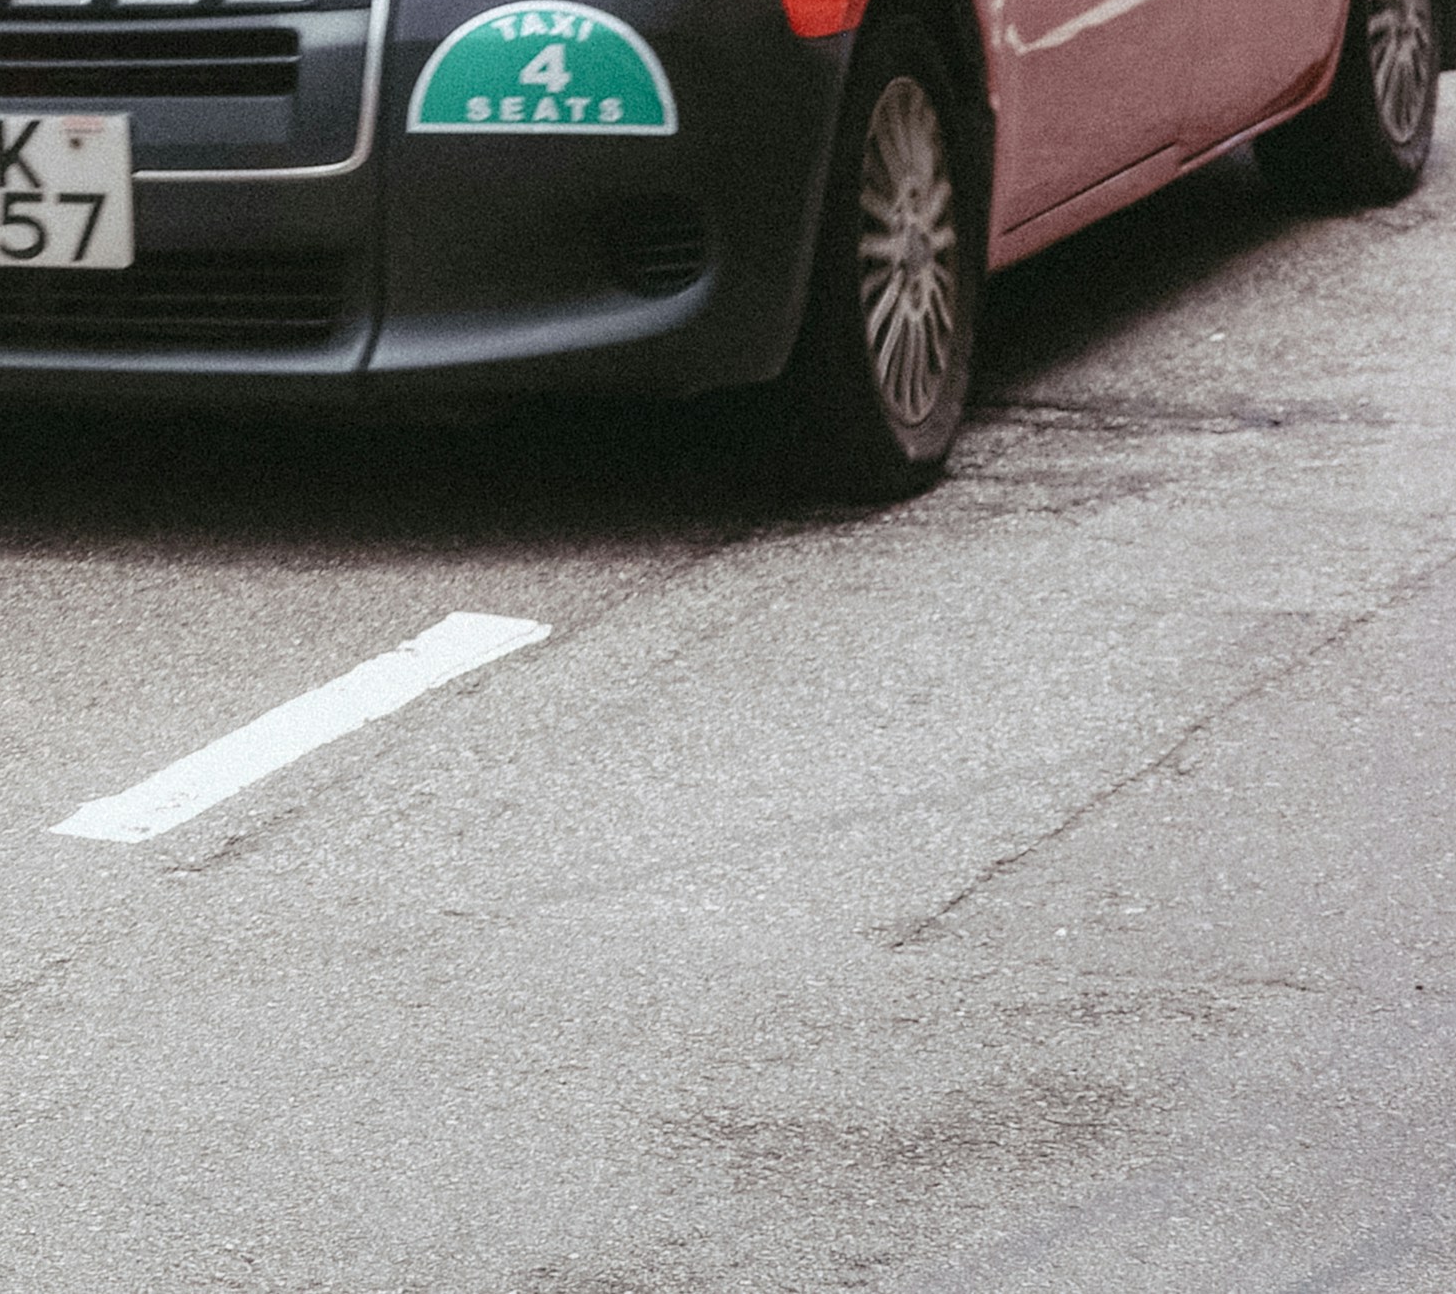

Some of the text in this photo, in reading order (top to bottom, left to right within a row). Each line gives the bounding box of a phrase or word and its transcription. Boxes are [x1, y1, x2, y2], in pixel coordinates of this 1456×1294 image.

[494, 10, 593, 42] TAXI
[519, 43, 571, 93] 4
[465, 96, 625, 123] SEATS
